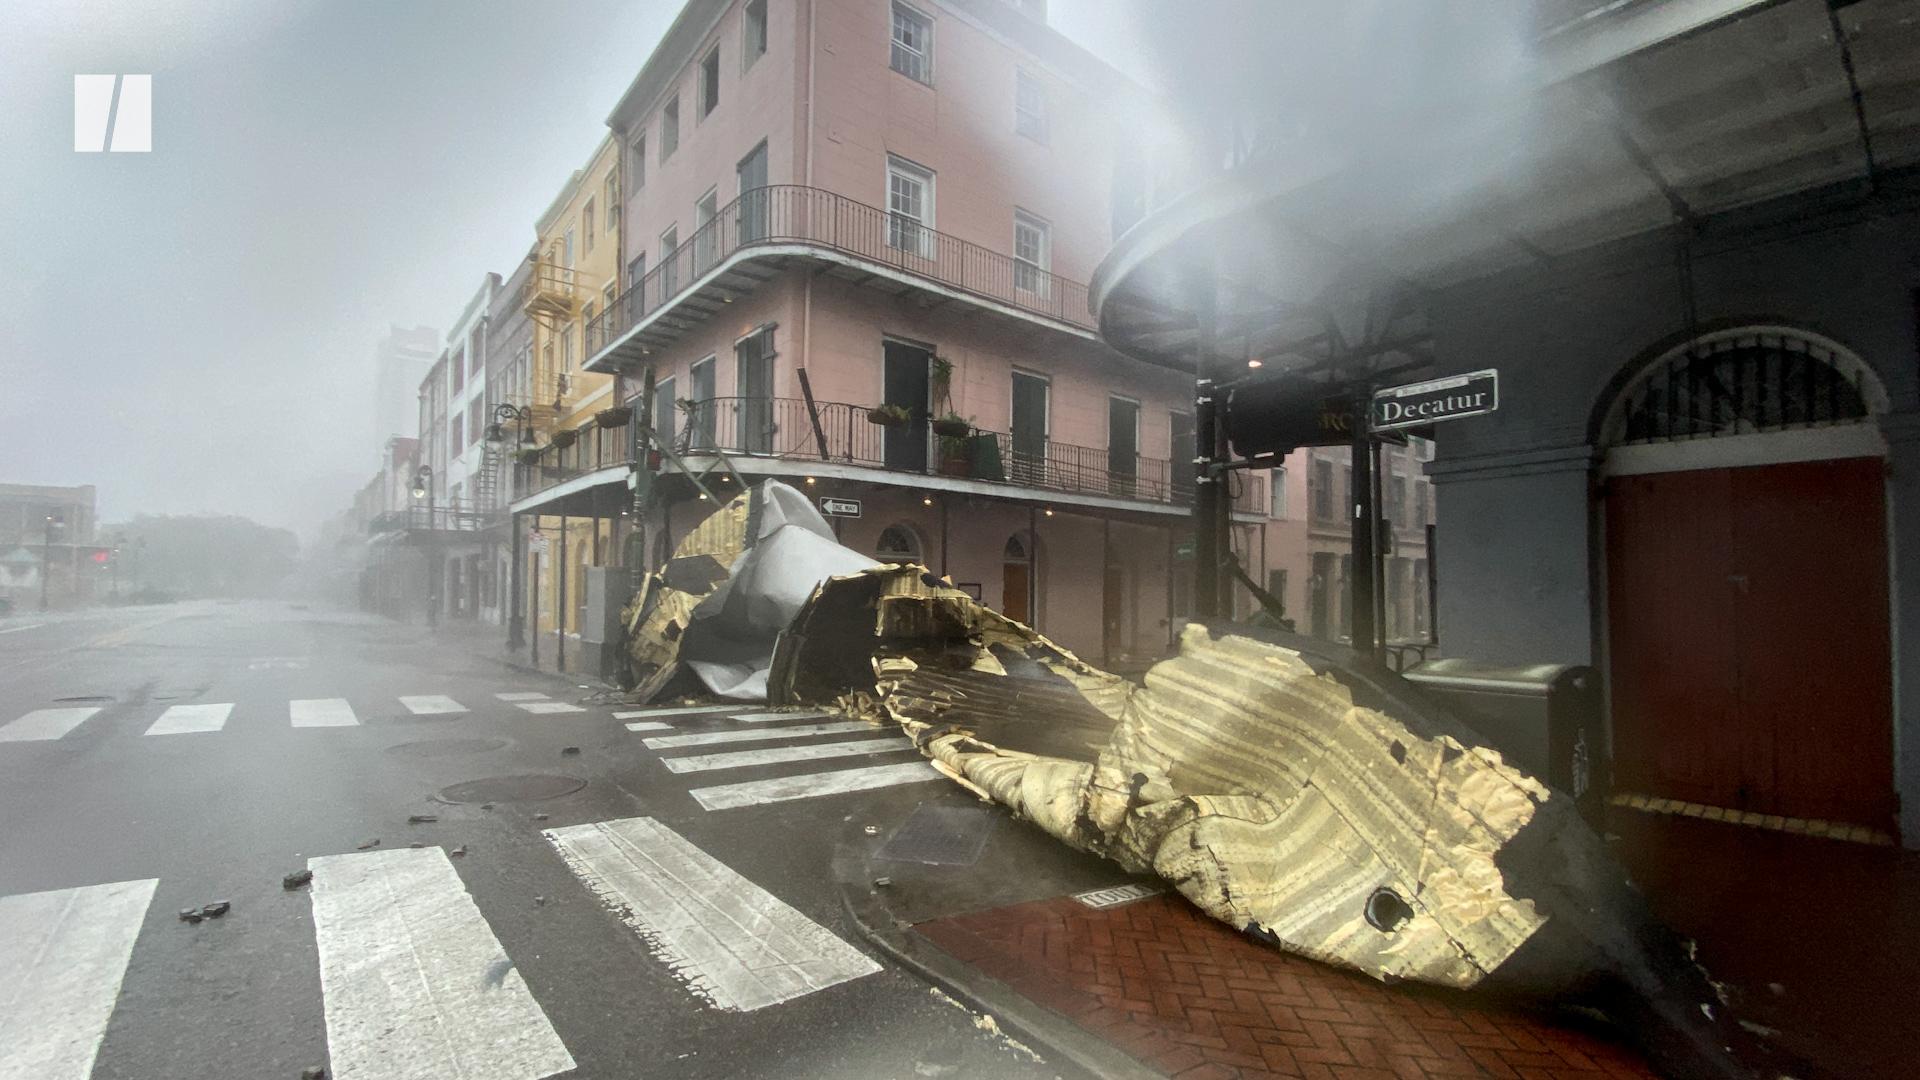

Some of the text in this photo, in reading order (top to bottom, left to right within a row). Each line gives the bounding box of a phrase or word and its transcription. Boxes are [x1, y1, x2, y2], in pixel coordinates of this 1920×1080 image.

[1383, 392, 1486, 421] Decatur
[832, 503, 856, 512] ONE WAY
